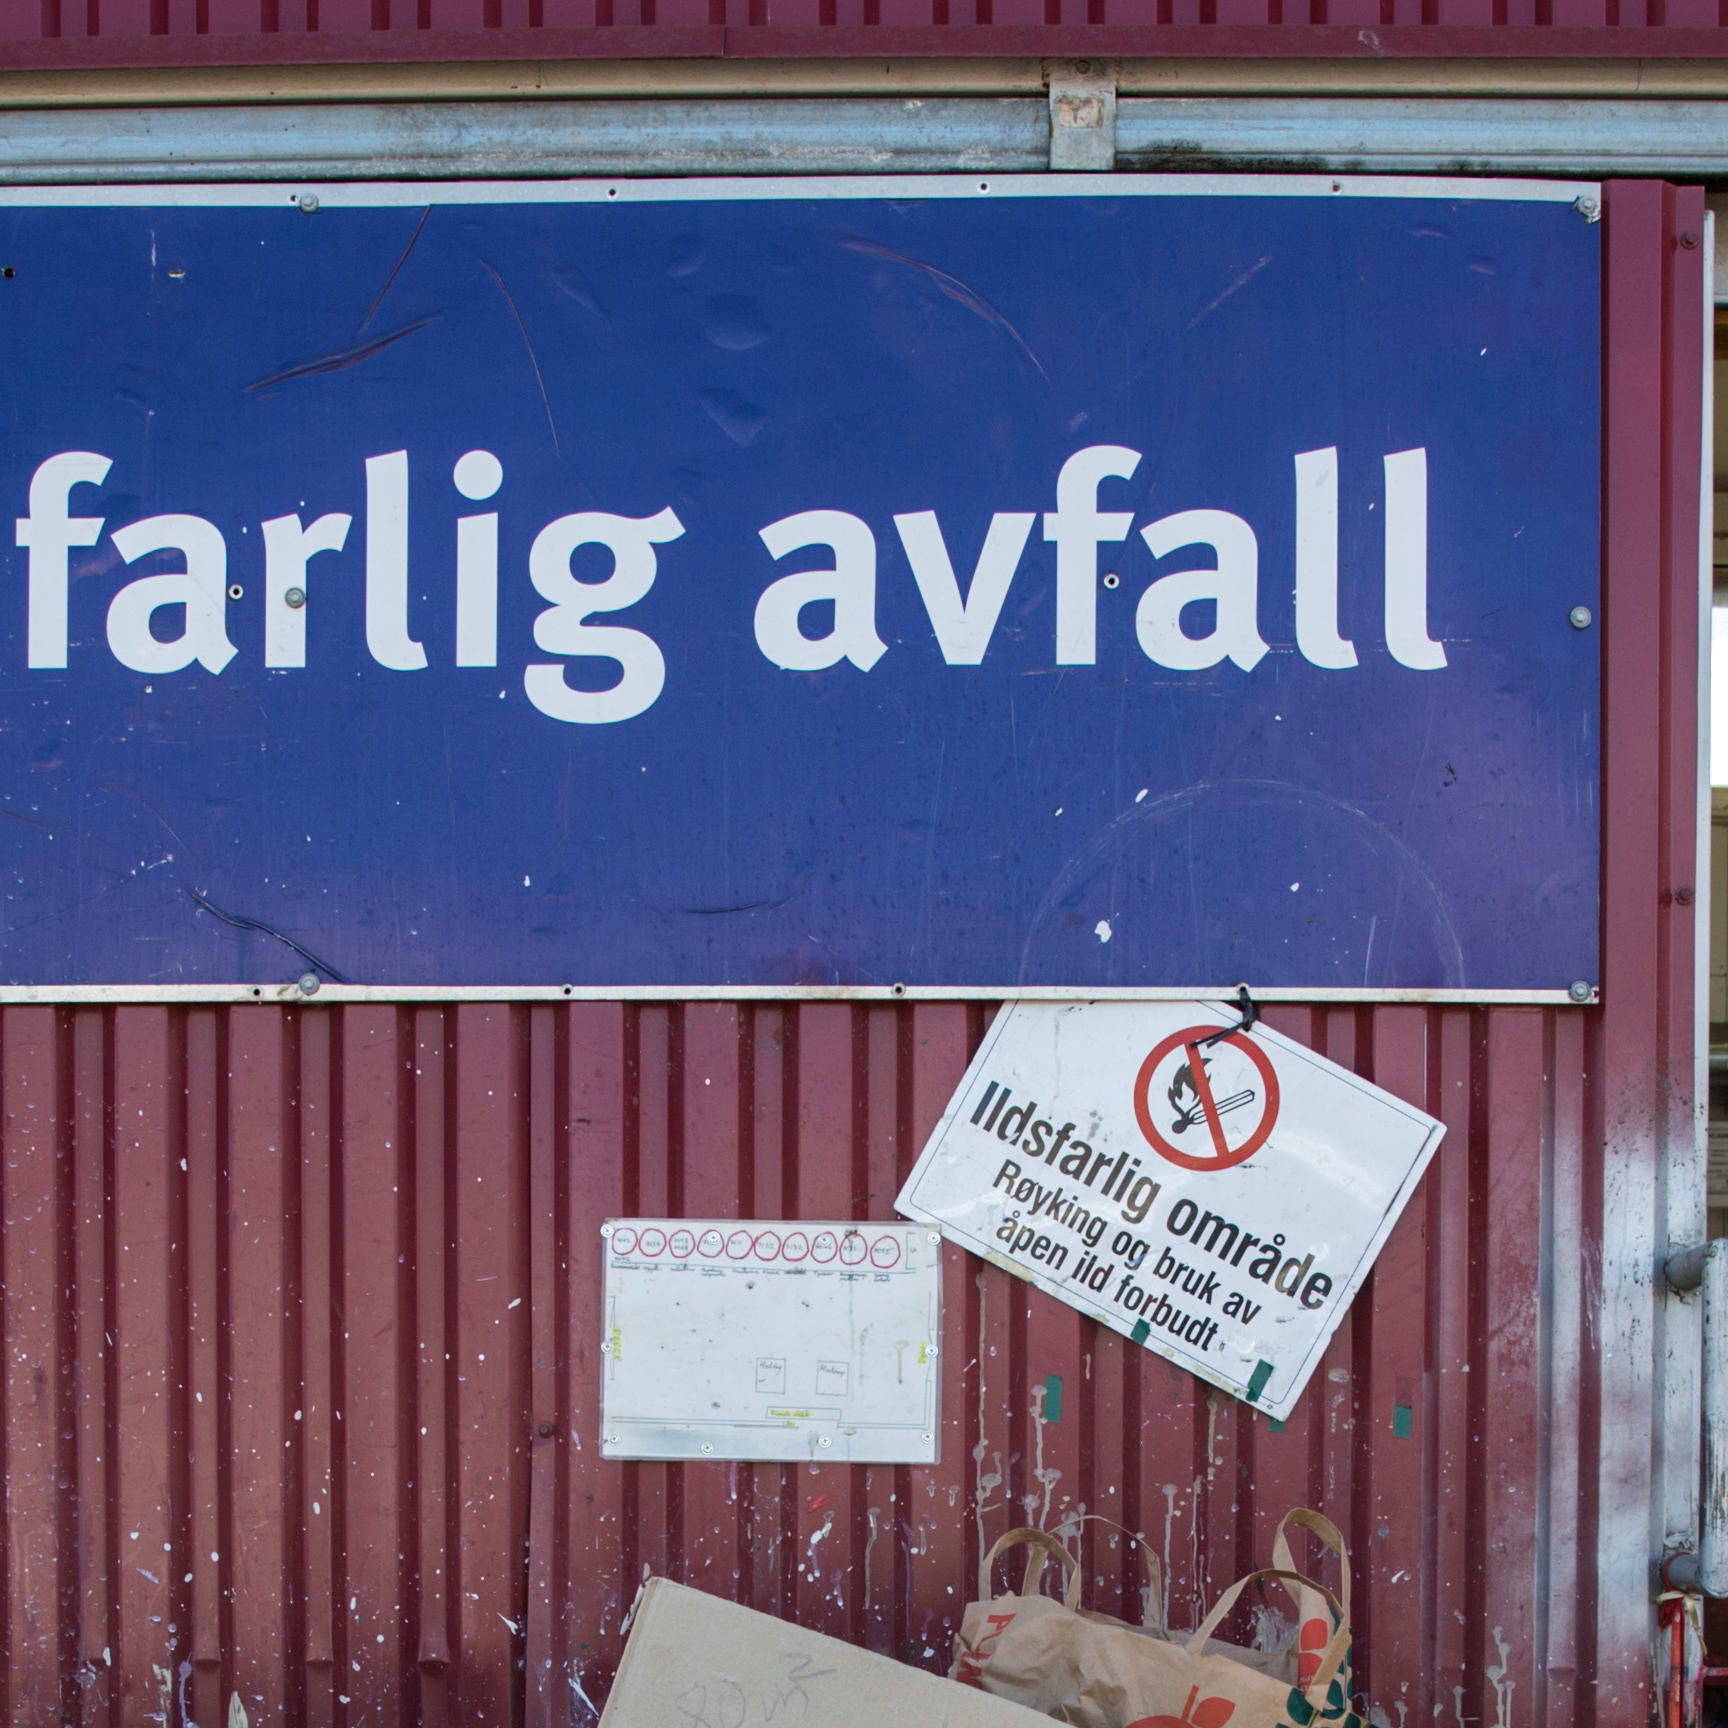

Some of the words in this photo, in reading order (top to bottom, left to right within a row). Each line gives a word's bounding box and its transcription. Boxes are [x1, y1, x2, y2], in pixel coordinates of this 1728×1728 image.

[15, 449, 686, 726] farlig
[754, 444, 1448, 674] avfall
[969, 1080, 1161, 1226] Ildsfarlig
[1166, 1198, 1333, 1311] område
[992, 1159, 1107, 1248] Røyking
[1112, 1230, 1150, 1270] og
[1156, 1246, 1220, 1305] bruk
[1223, 1287, 1262, 1326] av
[995, 1210, 1069, 1273] åpen
[1072, 1253, 1110, 1294] ild
[1114, 1275, 1219, 1352] forbudt
